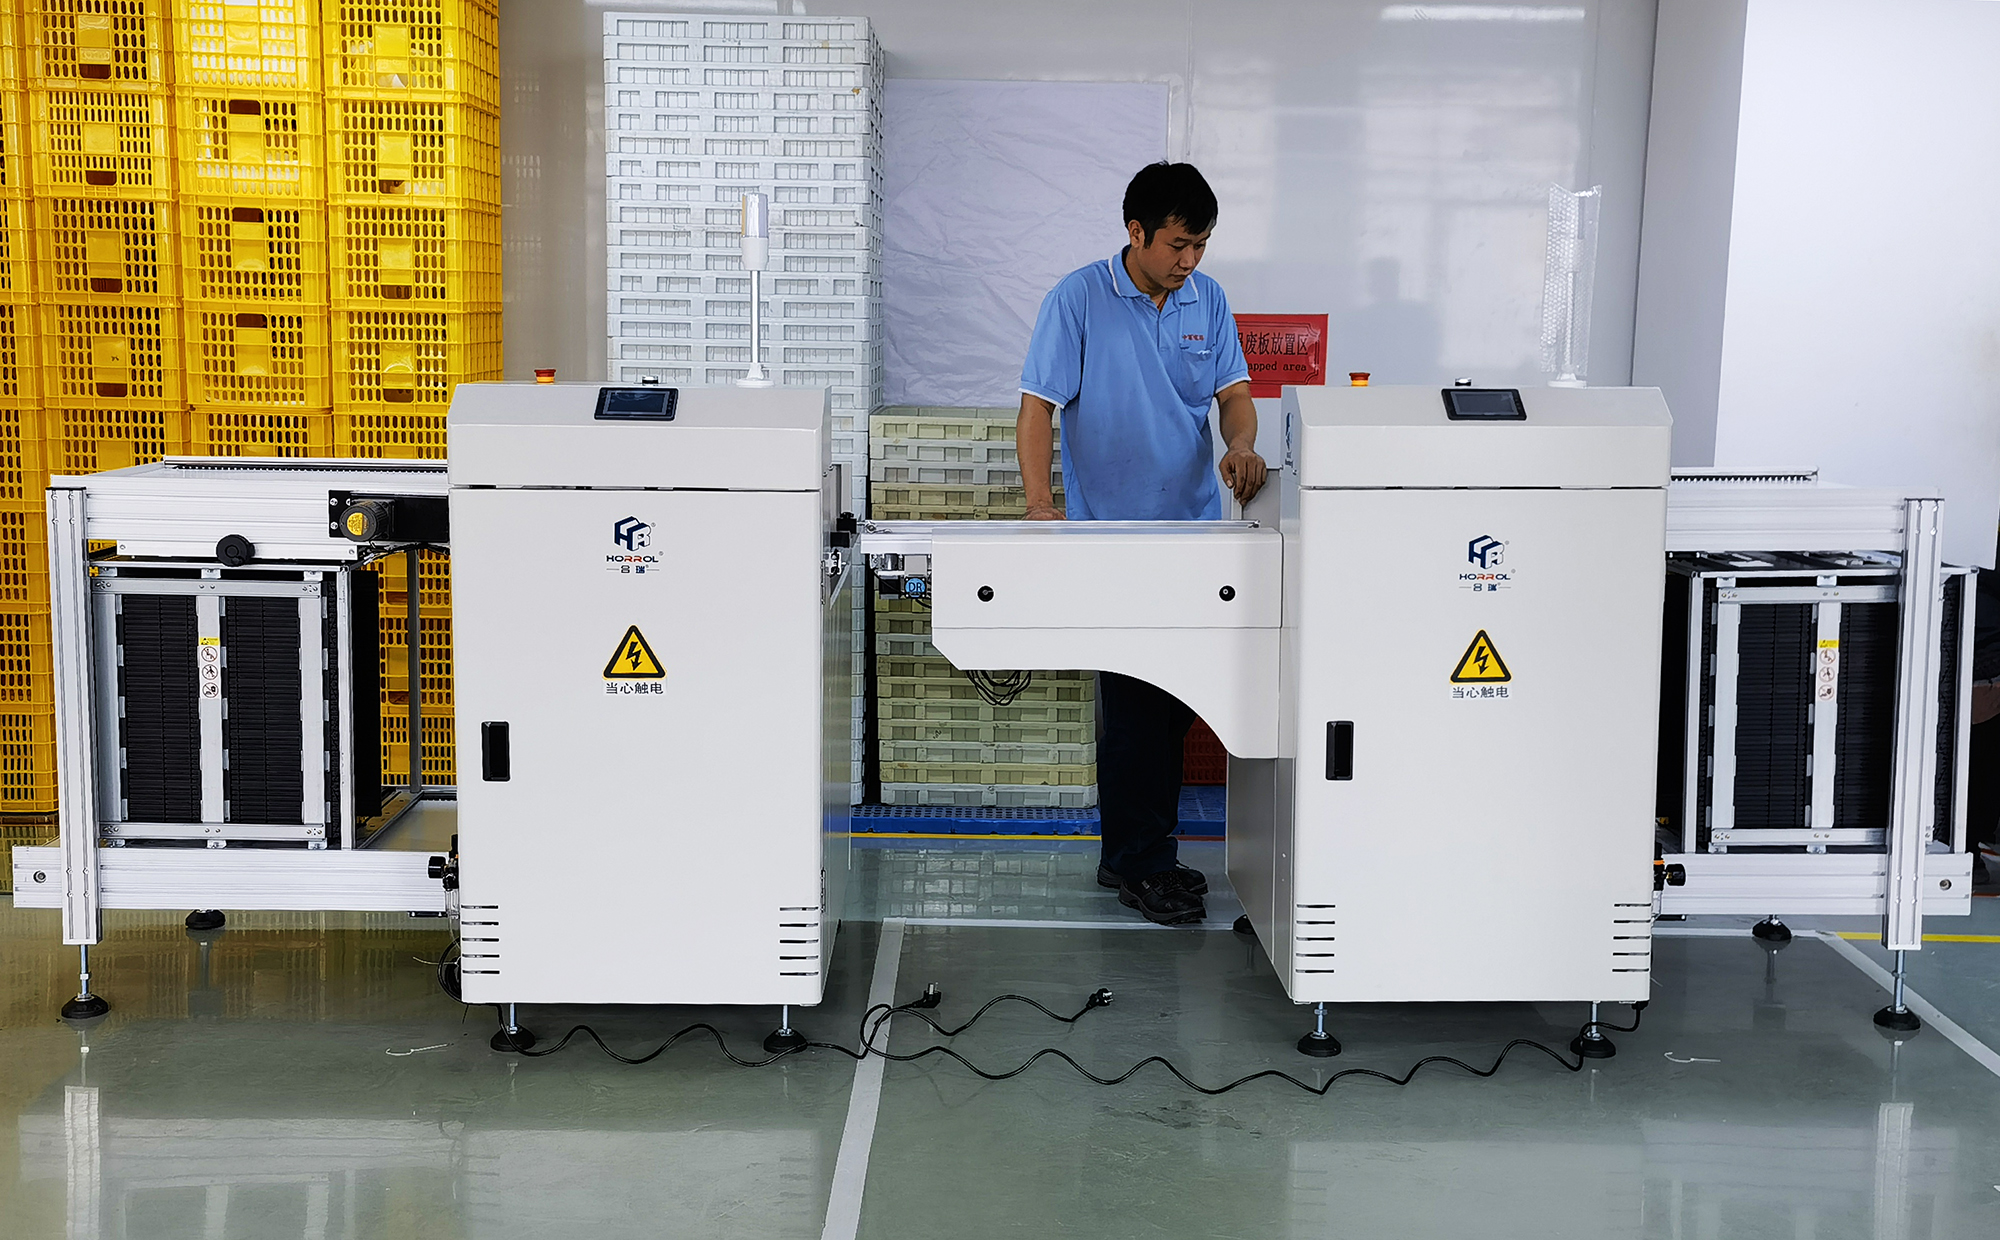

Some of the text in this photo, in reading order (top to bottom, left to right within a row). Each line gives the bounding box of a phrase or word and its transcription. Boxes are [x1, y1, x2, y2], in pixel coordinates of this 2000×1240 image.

[1248, 361, 1307, 372] apped area
[606, 555, 659, 563] HORROL
[908, 582, 922, 592] DR
[605, 682, 664, 695] 当心触电
[1452, 686, 1510, 699] 当心触电
